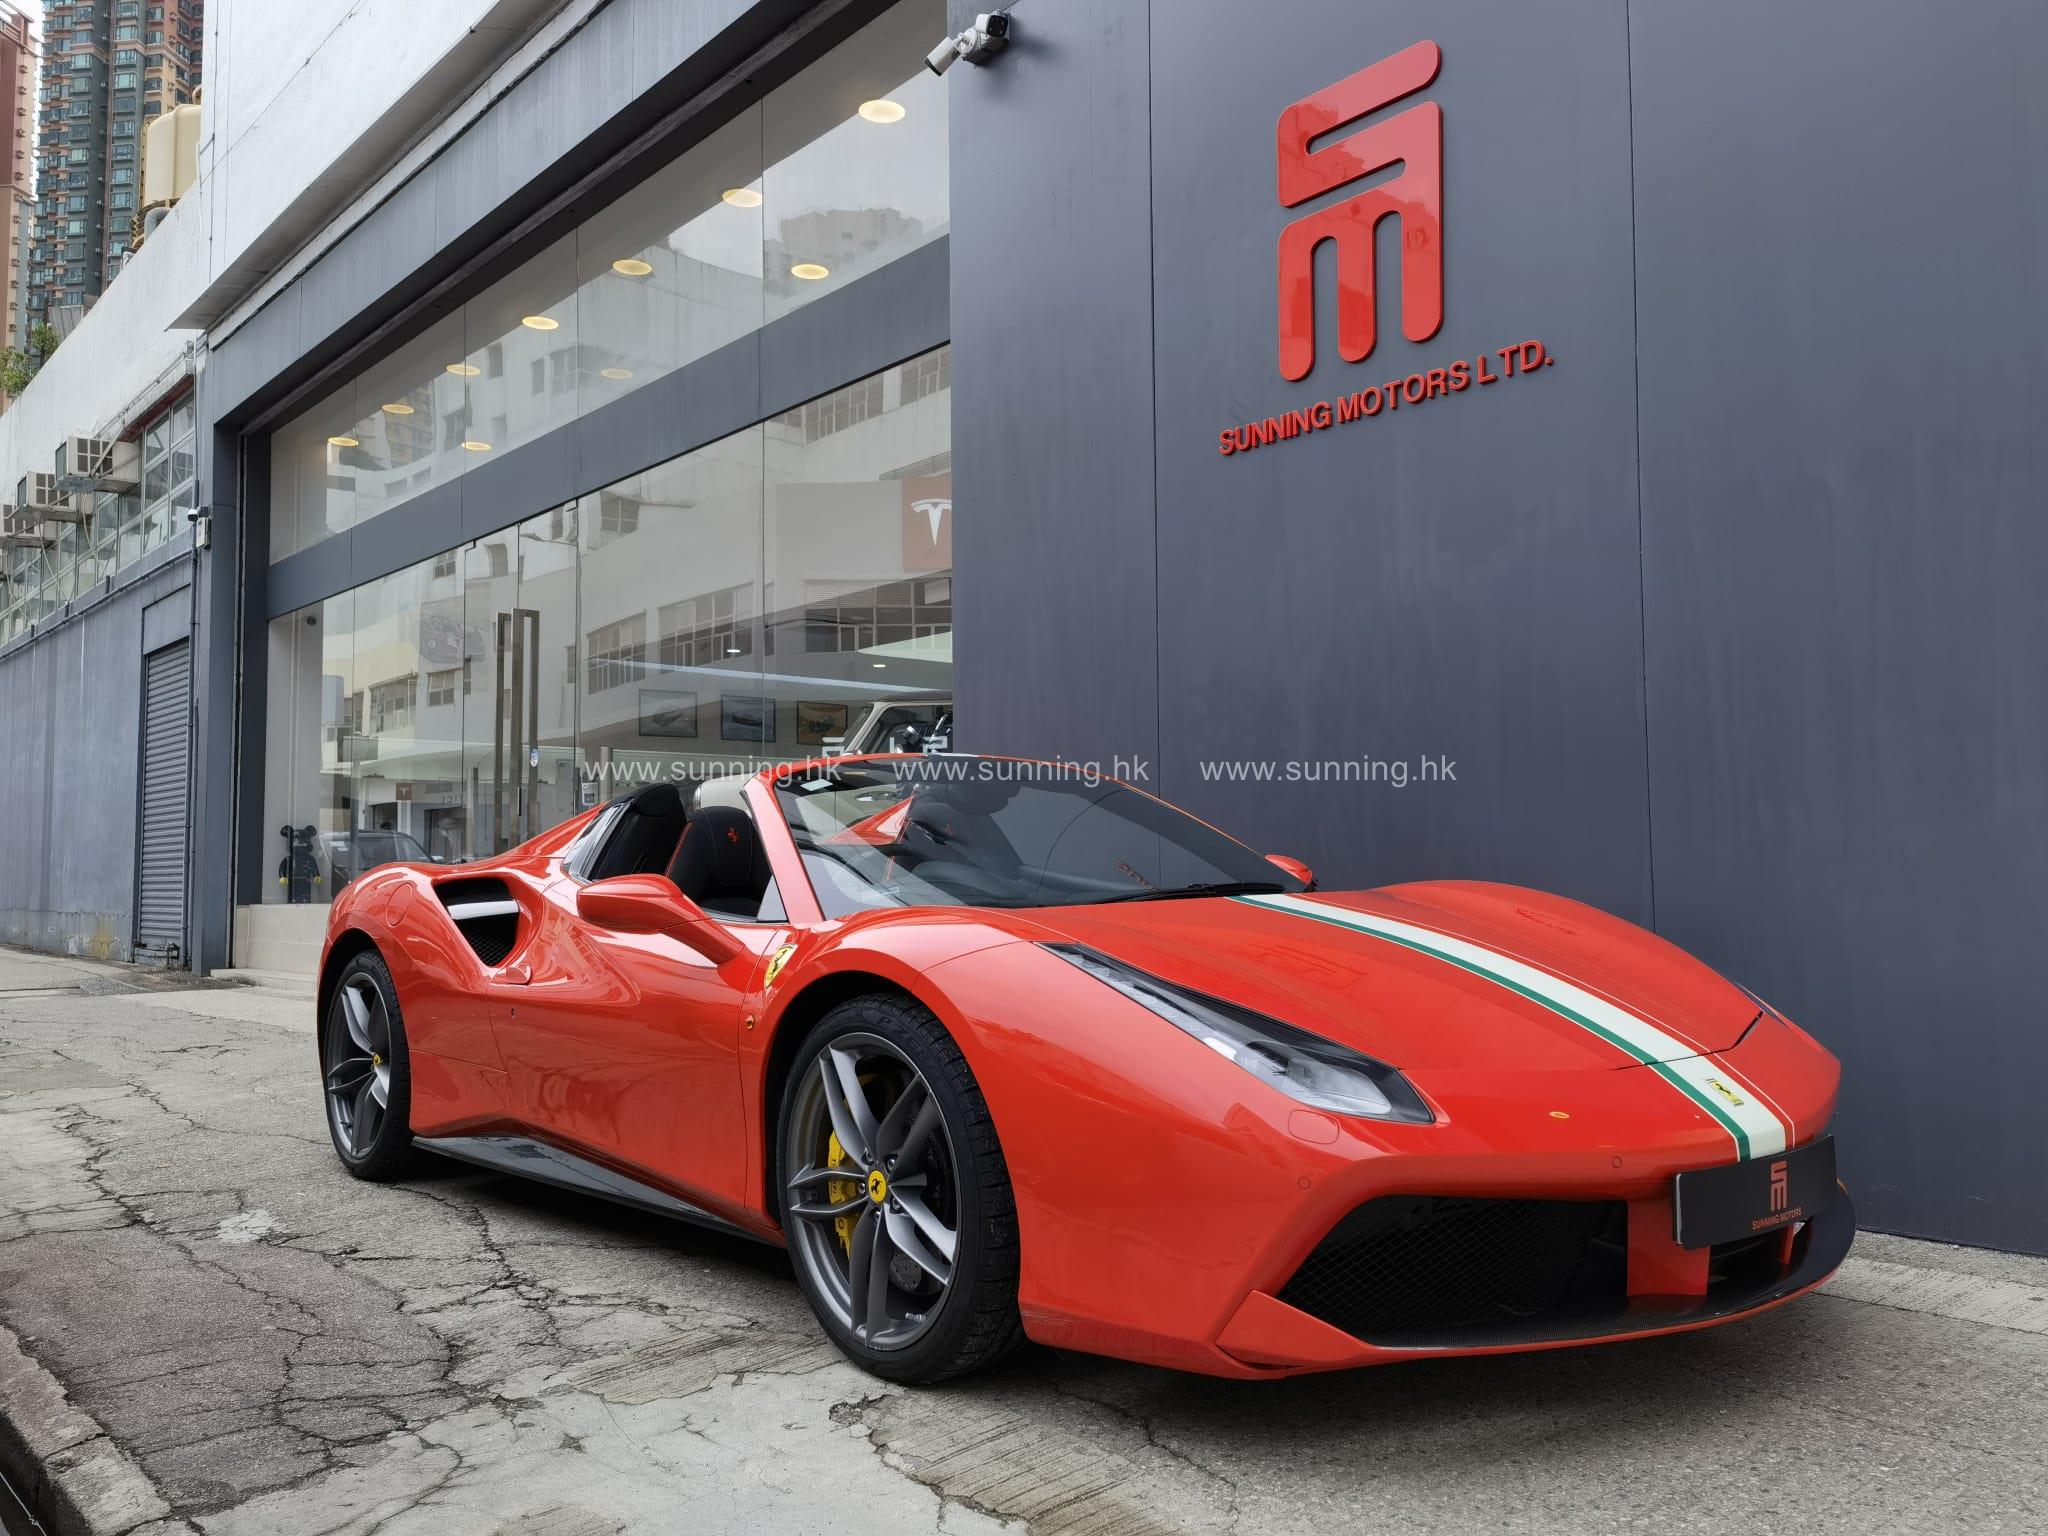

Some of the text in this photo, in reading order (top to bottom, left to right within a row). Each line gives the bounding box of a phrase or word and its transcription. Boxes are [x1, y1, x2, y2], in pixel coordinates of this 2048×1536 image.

[1218, 338, 1555, 457] SUNNING MOTORS LTD.
[1752, 1215, 1779, 1230] SUNNING
